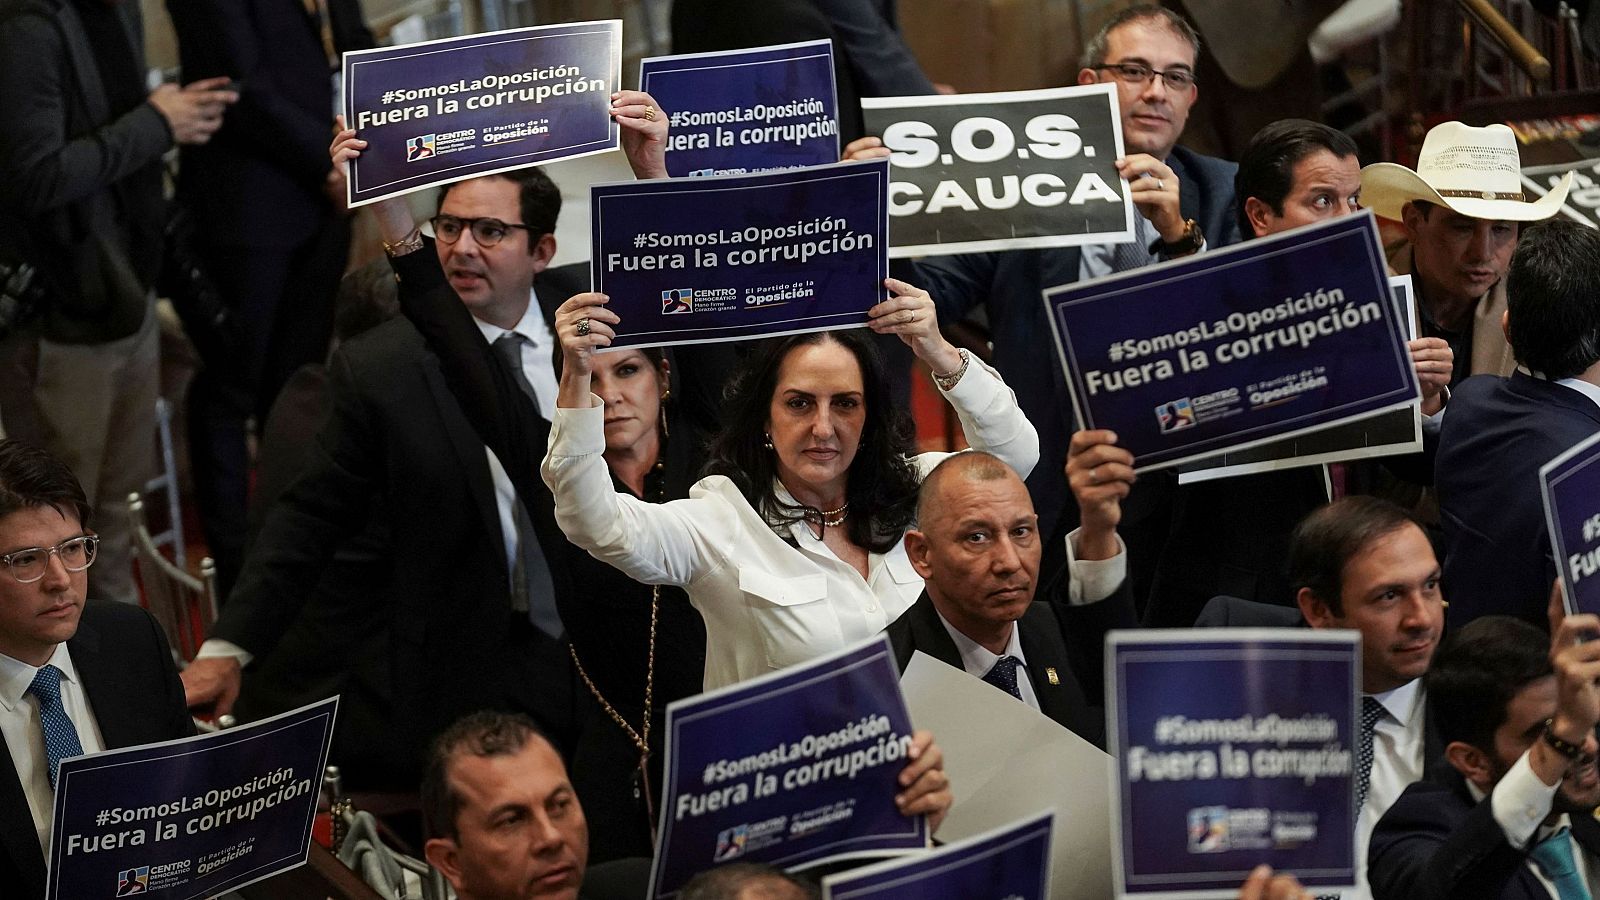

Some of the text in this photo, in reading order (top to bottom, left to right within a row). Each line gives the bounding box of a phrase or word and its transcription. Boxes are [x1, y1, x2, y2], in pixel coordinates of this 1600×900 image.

[381, 65, 580, 105] #SomosLaOposición
[358, 76, 605, 130] Fuera la corrupción
[670, 97, 824, 128] #SomosLaOposición
[436, 128, 476, 140] CENTRO
[483, 125, 548, 142] Oposición
[494, 122, 526, 131] Partido
[665, 115, 837, 151] uera la corrupción
[882, 114, 1096, 168] S.O.S.
[889, 172, 1122, 216] CAUCA
[634, 216, 846, 248] #SomosLaOposición
[608, 232, 873, 272] Fuera la corrupción
[694, 288, 736, 297] CENTRO
[746, 288, 814, 305] Oposición
[757, 284, 790, 292] Partido
[1108, 286, 1344, 363] #SomosLaOposición
[1085, 301, 1381, 395] Fuera la corrupción
[702, 713, 890, 785] #SomosLaOposición
[676, 783, 748, 820] Fuera
[754, 773, 778, 799] la
[783, 732, 913, 790] corrupción
[96, 766, 294, 826] #SomosLaOposición
[67, 778, 311, 856] Fuera la corrupción
[150, 860, 191, 874] CENTRO
[197, 845, 253, 874] Oposición
[208, 846, 235, 860] Partido
[150, 868, 190, 880] DEMOCRÁTICO
